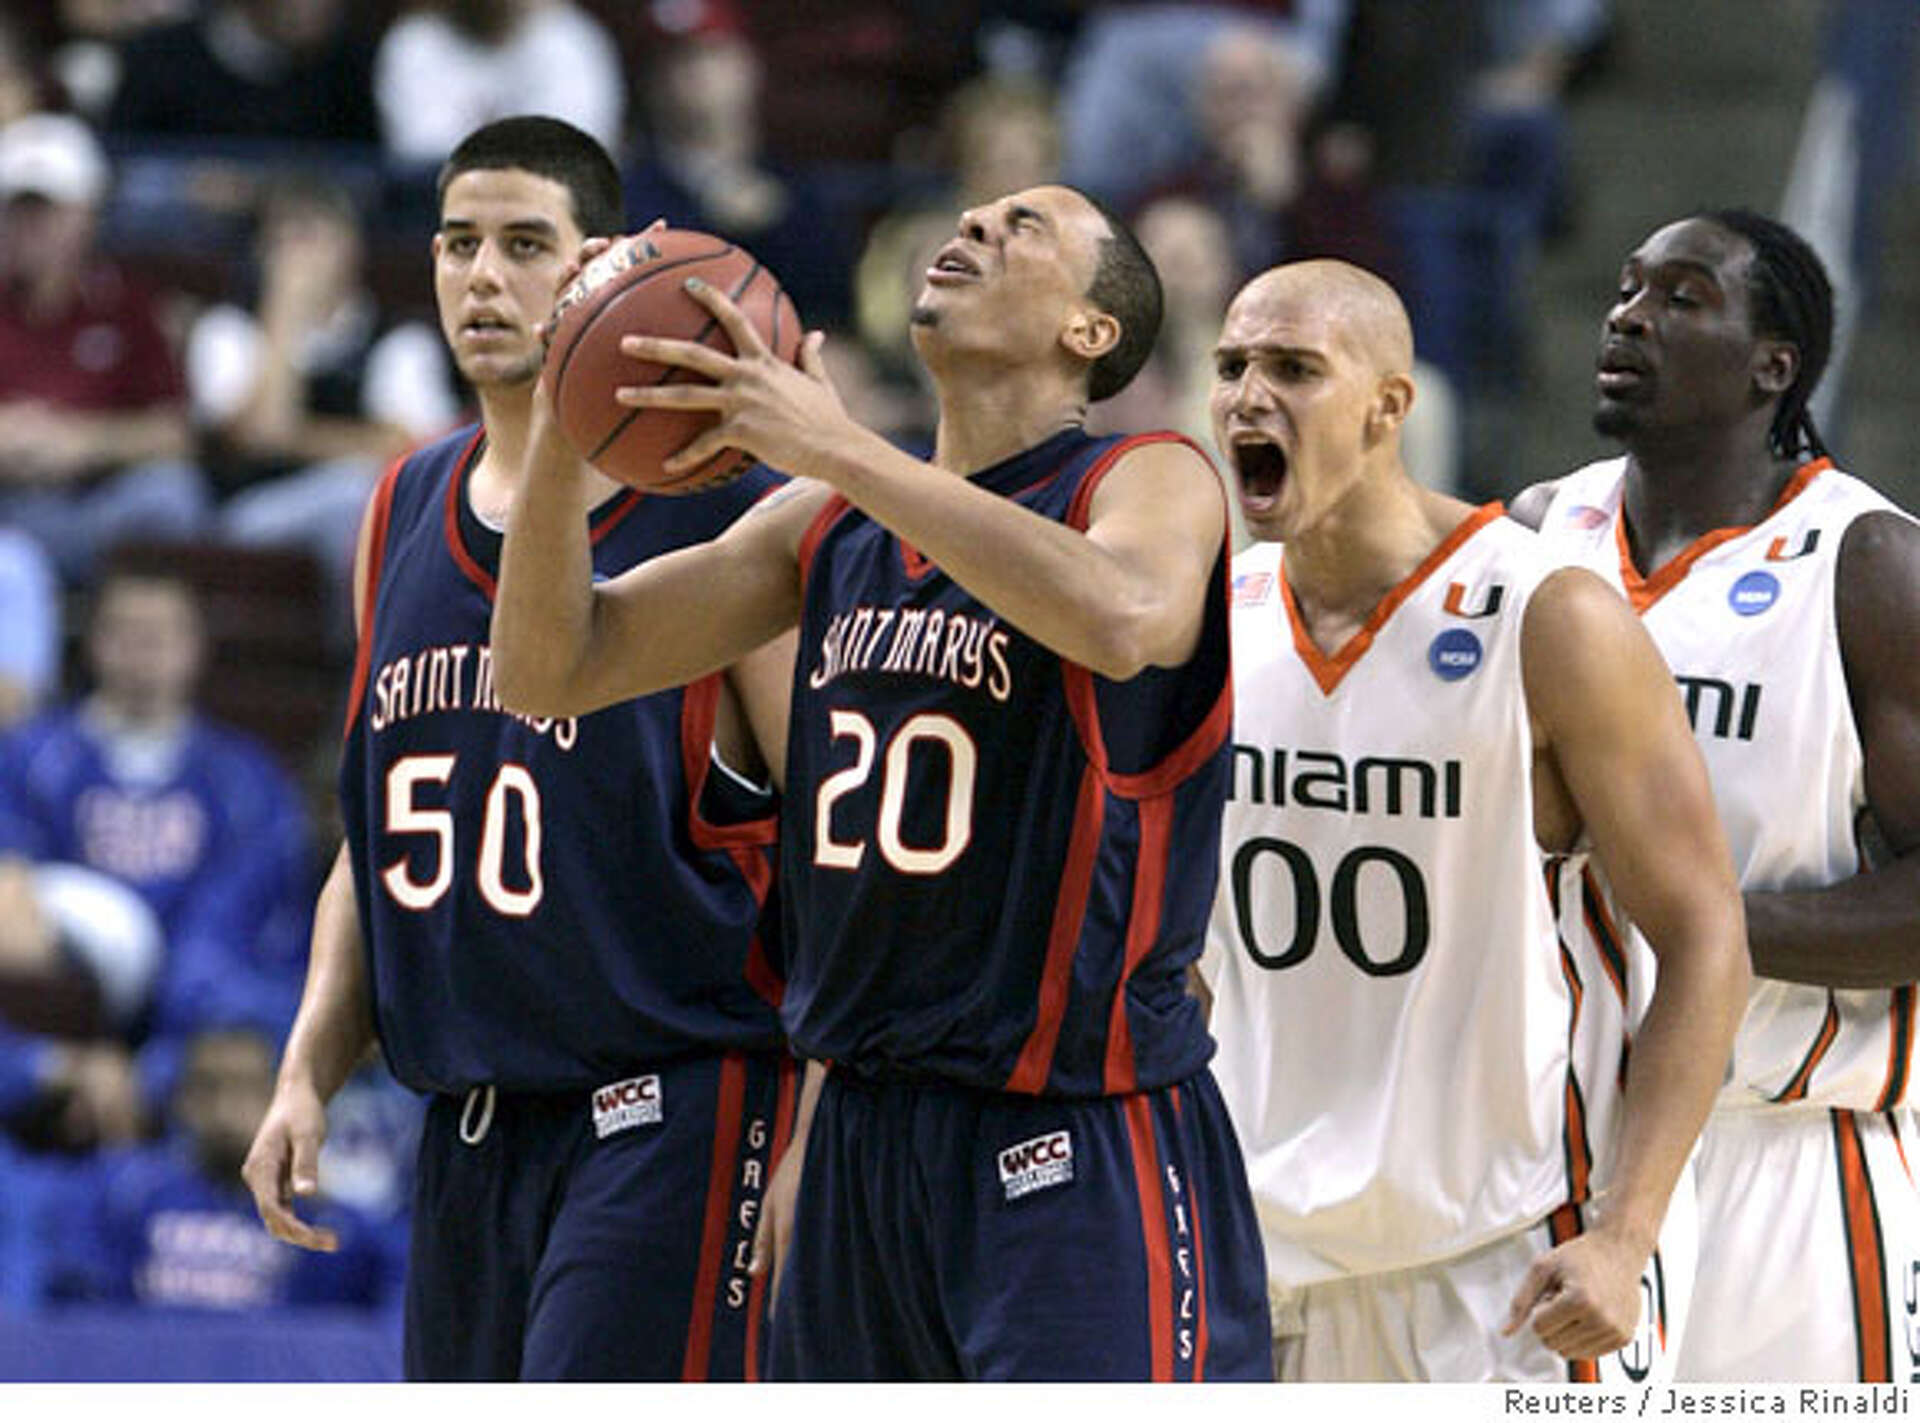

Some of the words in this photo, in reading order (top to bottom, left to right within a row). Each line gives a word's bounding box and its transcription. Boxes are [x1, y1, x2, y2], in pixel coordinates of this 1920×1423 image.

[1443, 582, 1504, 619] U
[371, 645, 469, 731] SAINT
[809, 606, 895, 690] SAINT
[381, 752, 544, 918] 50
[812, 709, 977, 876] 20
[1231, 836, 1431, 978] 00
[597, 1078, 657, 1113] WCC
[1003, 1136, 1067, 1175] WCC
